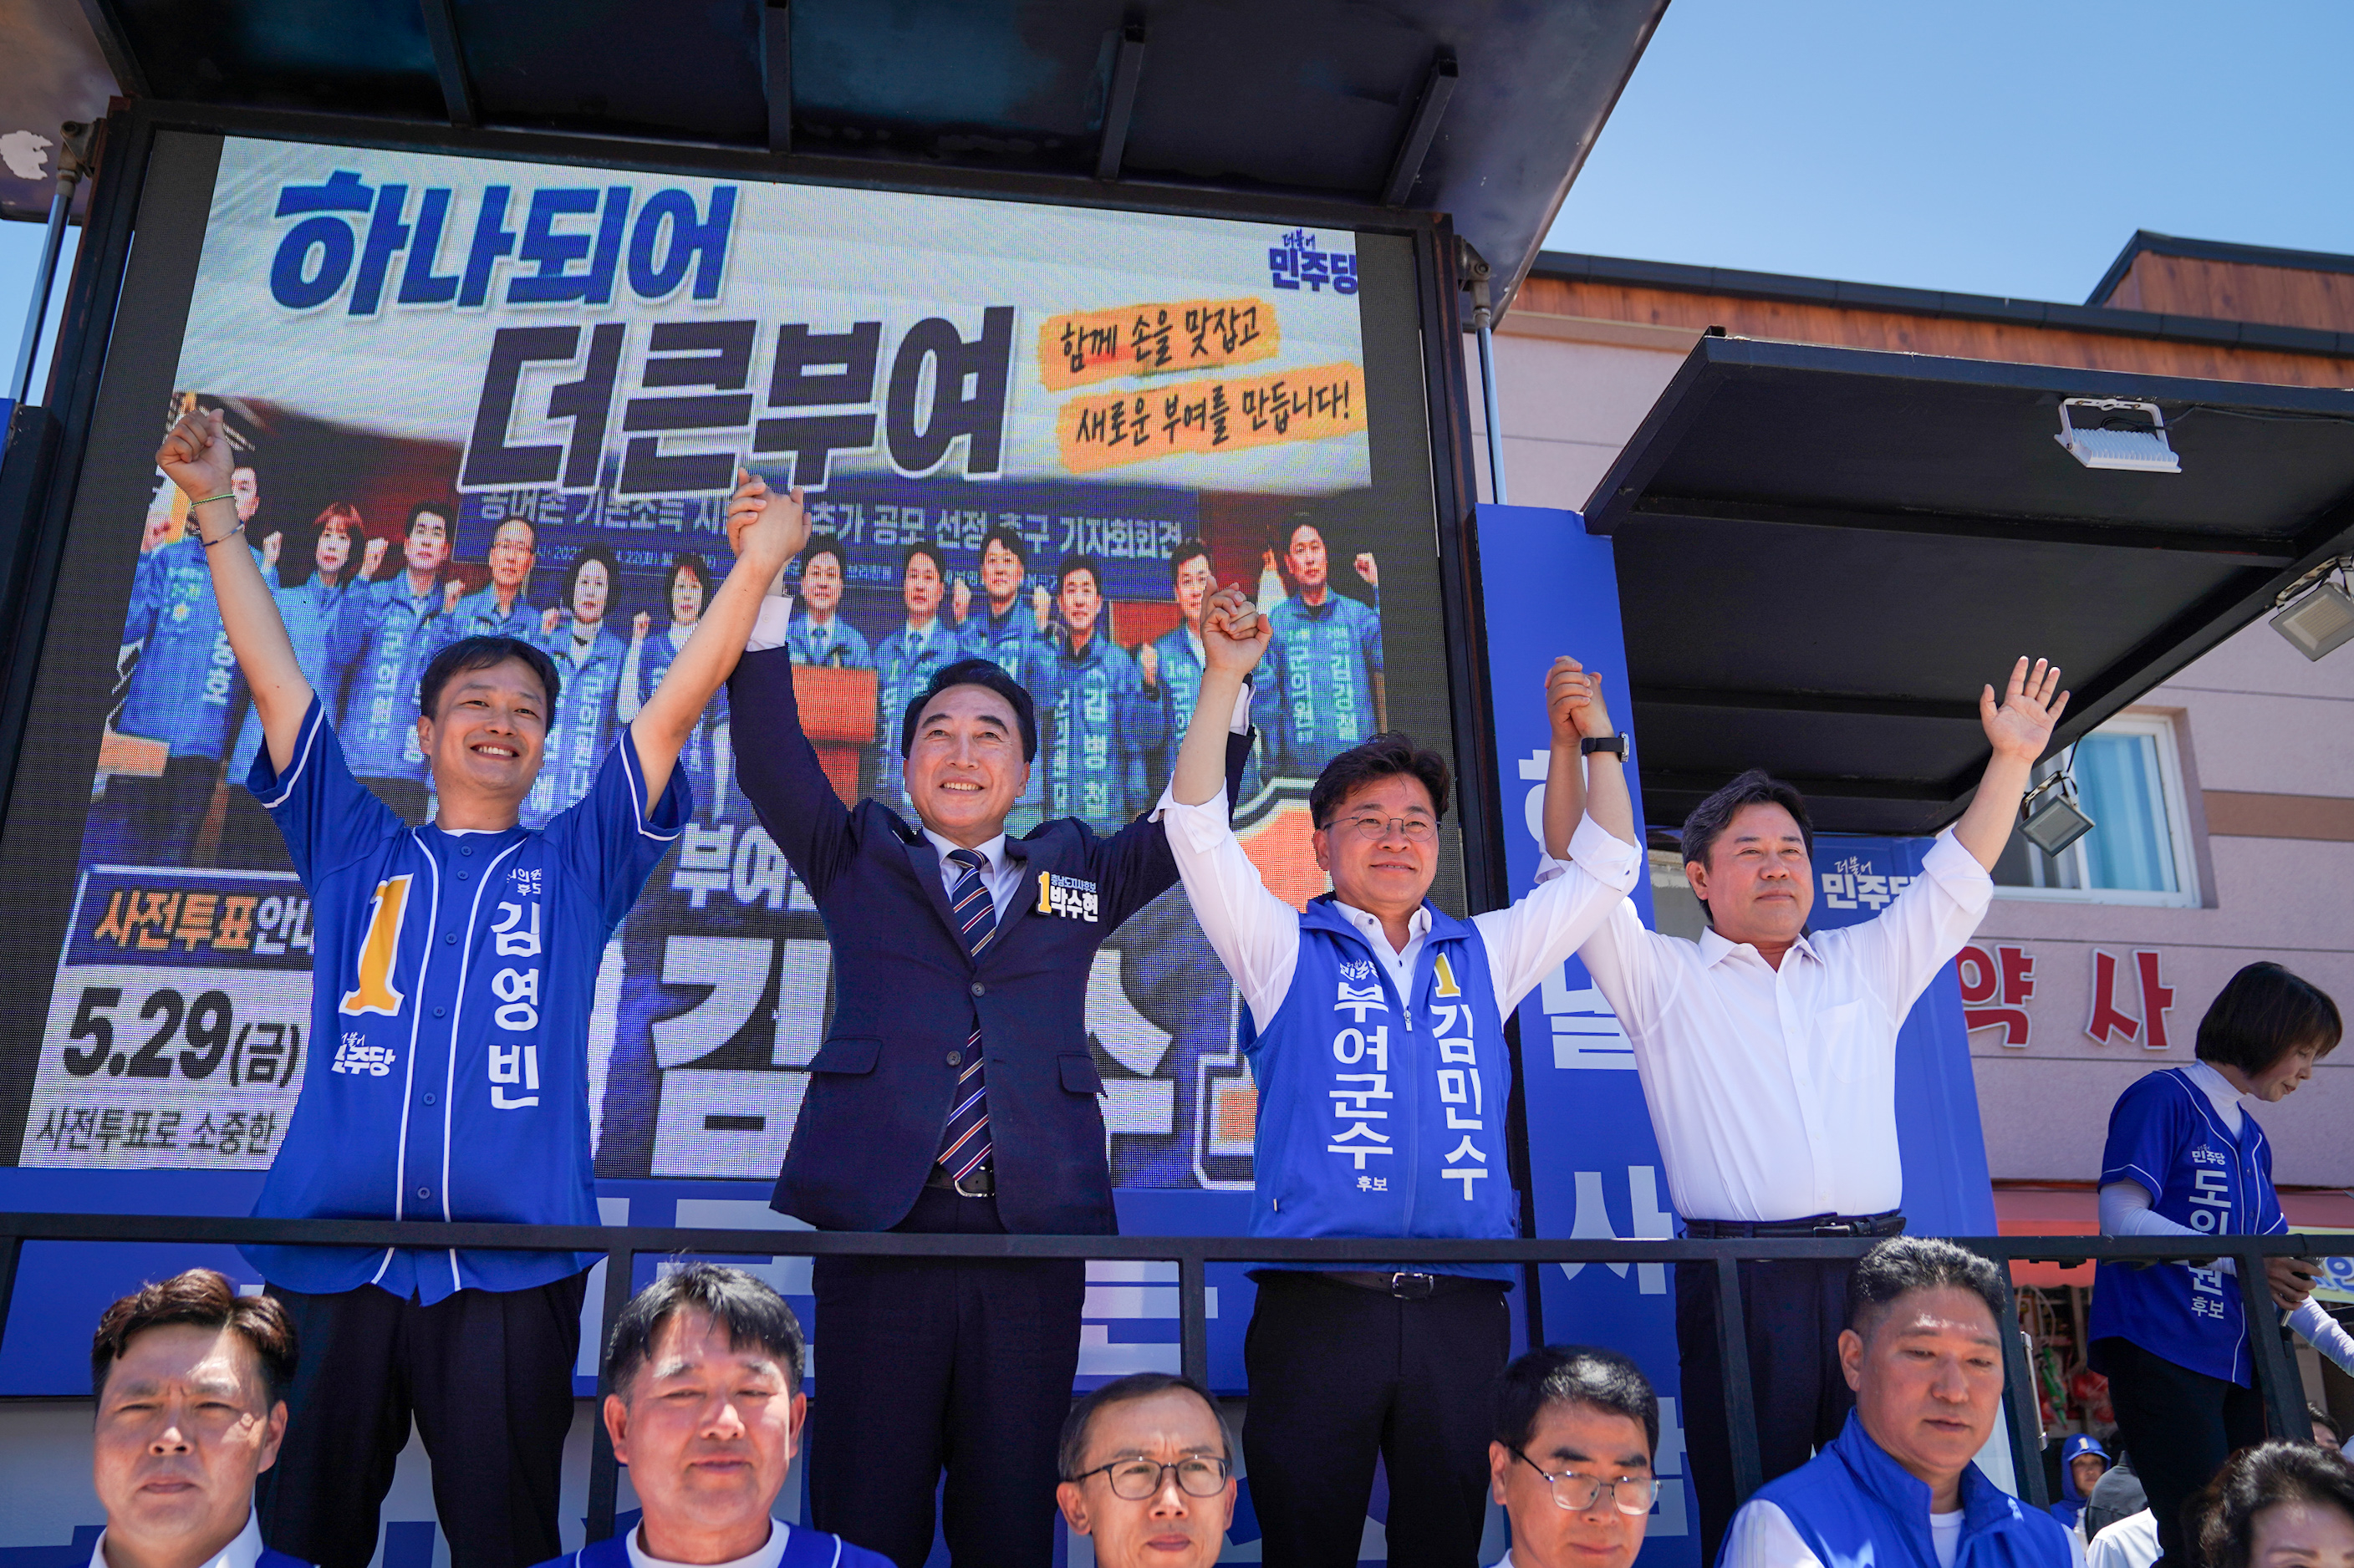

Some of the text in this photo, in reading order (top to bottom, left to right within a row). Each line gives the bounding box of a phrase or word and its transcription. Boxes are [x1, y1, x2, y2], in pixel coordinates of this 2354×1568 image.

[269, 170, 738, 316] 하나되어
[1059, 306, 1261, 373] 함께 손을 맞잡고
[1076, 379, 1352, 448] 새로운 부여를 만듭니다!
[1833, 855, 1873, 877] 더불어
[1049, 885, 1098, 923] 박수현
[338, 873, 415, 1017] 1
[1433, 952, 1461, 998] 1
[62, 987, 303, 1089] 5.29(금)
[488, 900, 543, 1111] 김영빈
[1327, 981, 1394, 1170] 부여군수
[1429, 1003, 1489, 1201] 김민수
[36, 1107, 276, 1156] 사전투표로 소중한
[2191, 1150, 2226, 1166] 민주당
[1356, 1175, 1388, 1193] 후보
[2191, 1296, 2224, 1320] 후보
